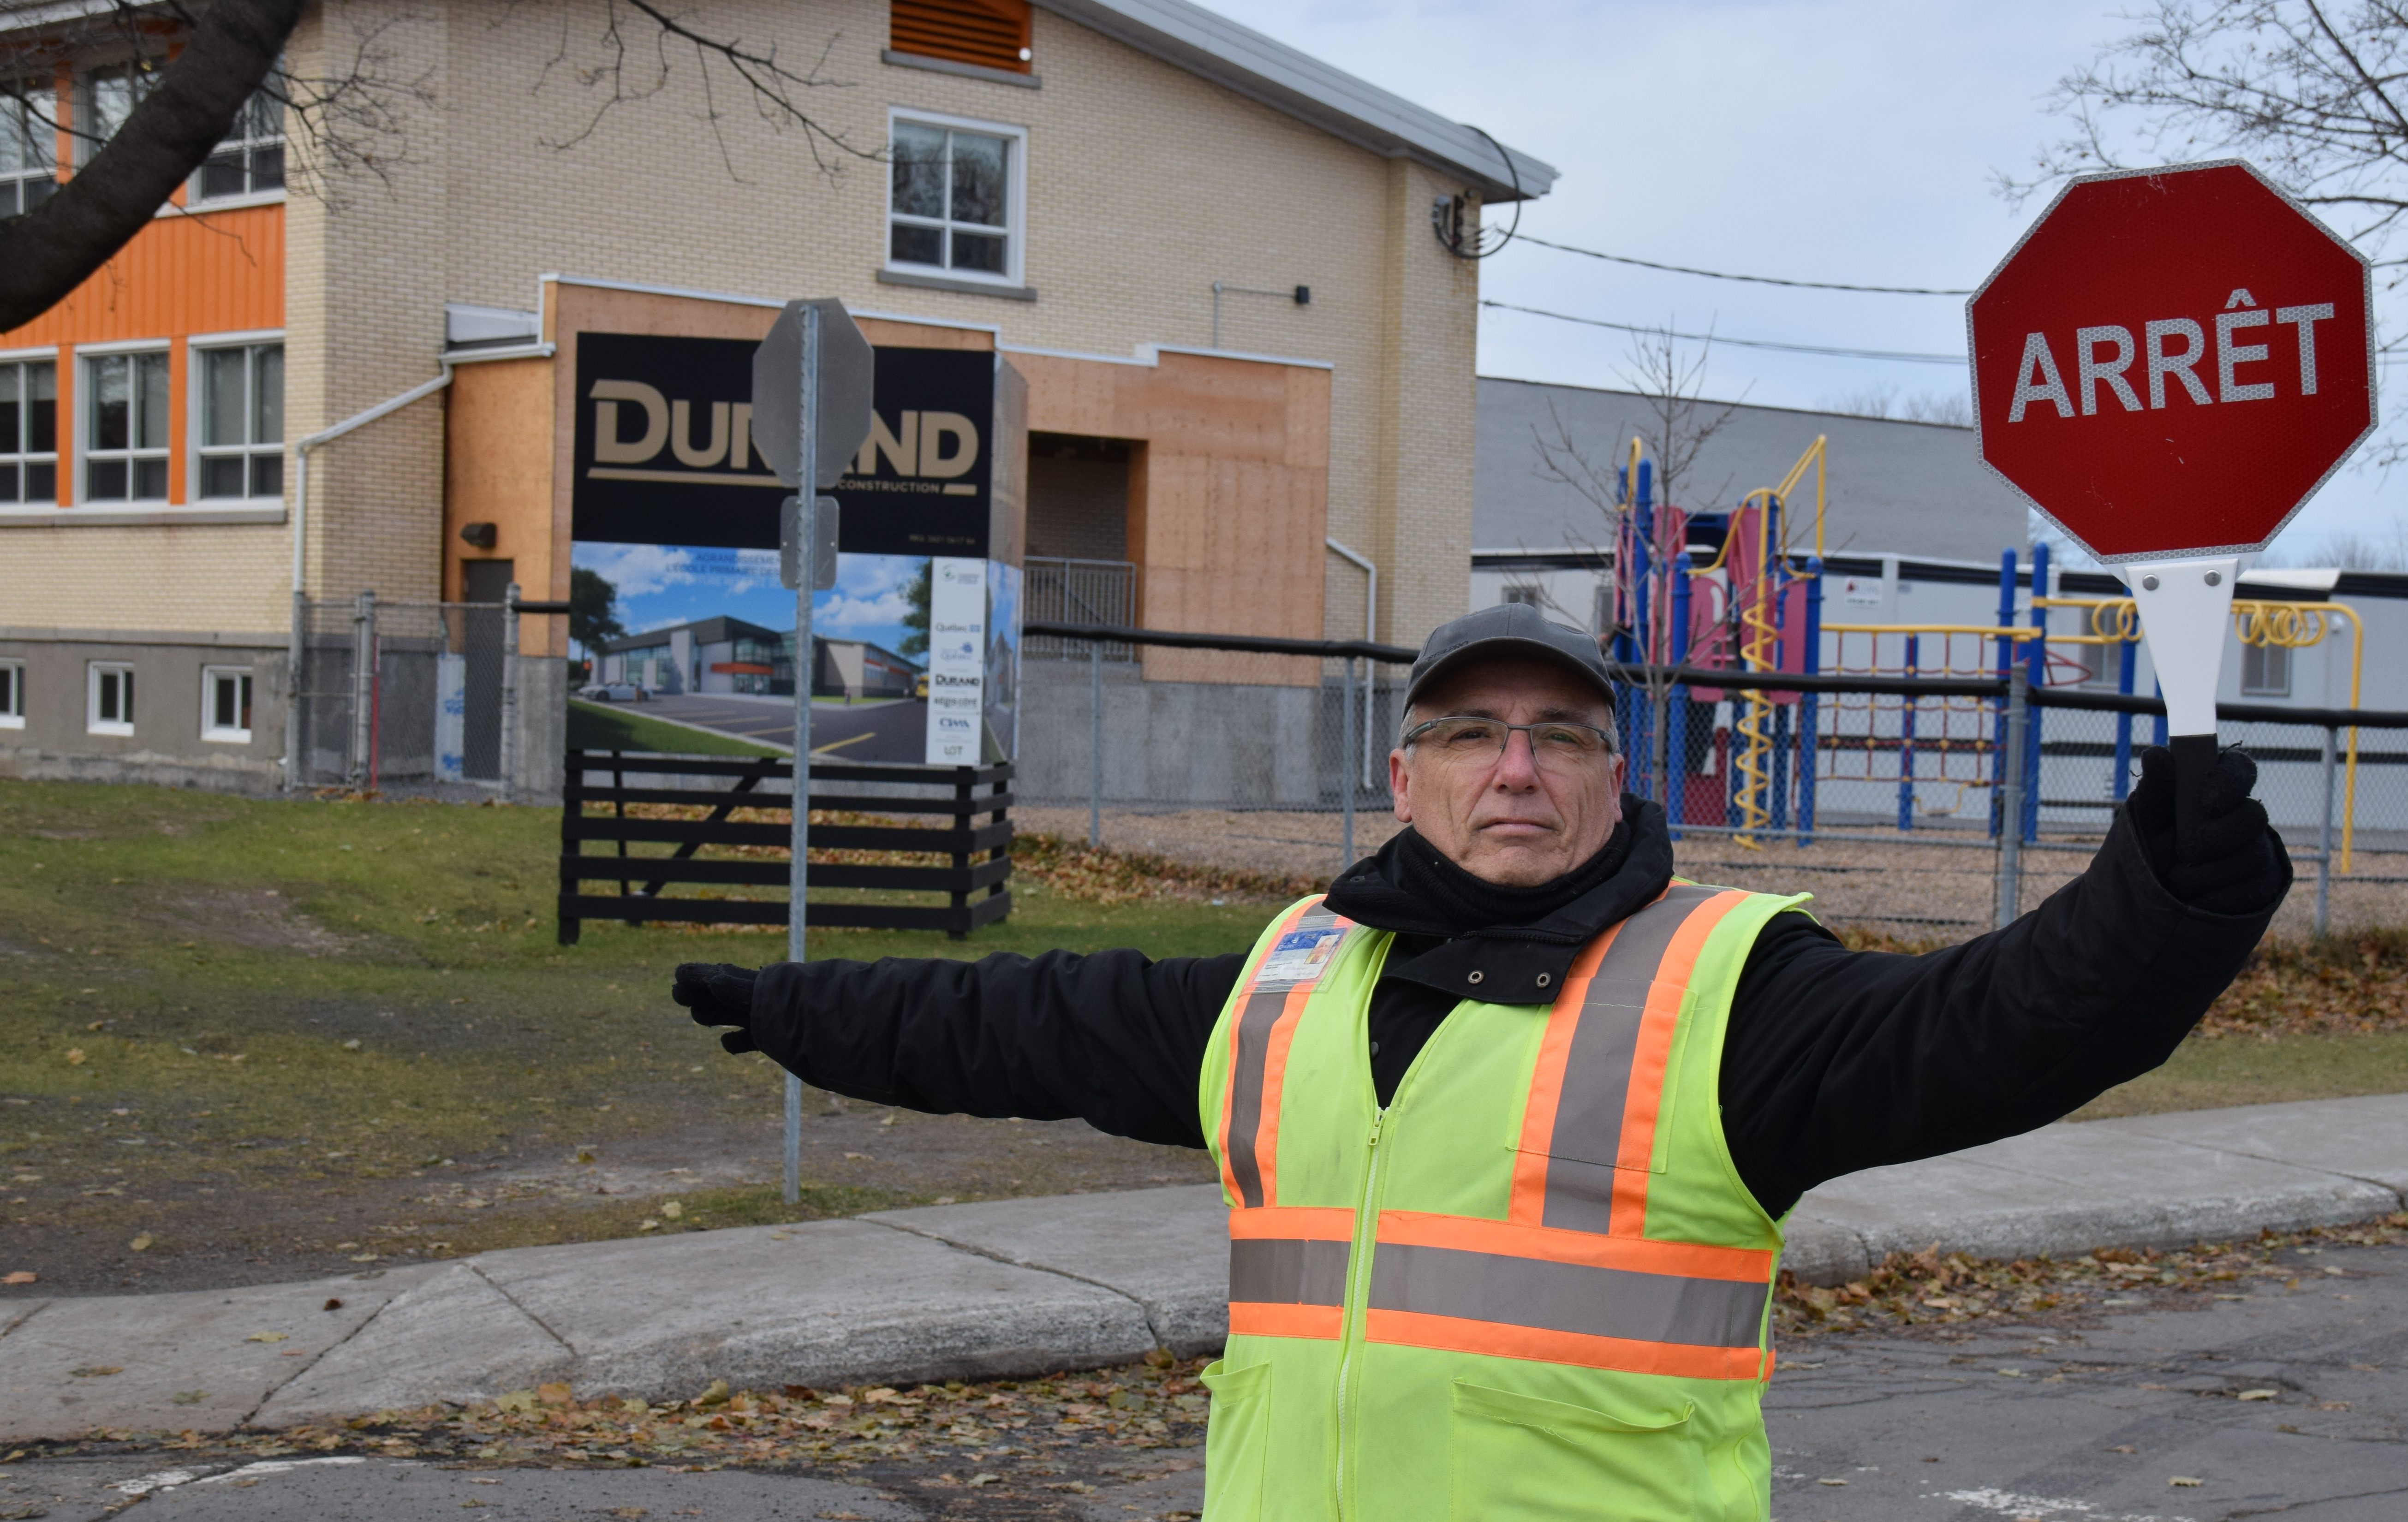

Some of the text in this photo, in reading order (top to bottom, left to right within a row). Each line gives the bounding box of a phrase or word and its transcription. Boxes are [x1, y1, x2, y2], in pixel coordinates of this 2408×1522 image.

[2008, 288, 2334, 423] ARRÊT
[588, 379, 979, 478] DUND
[838, 480, 940, 493] CONSTRUCTION
